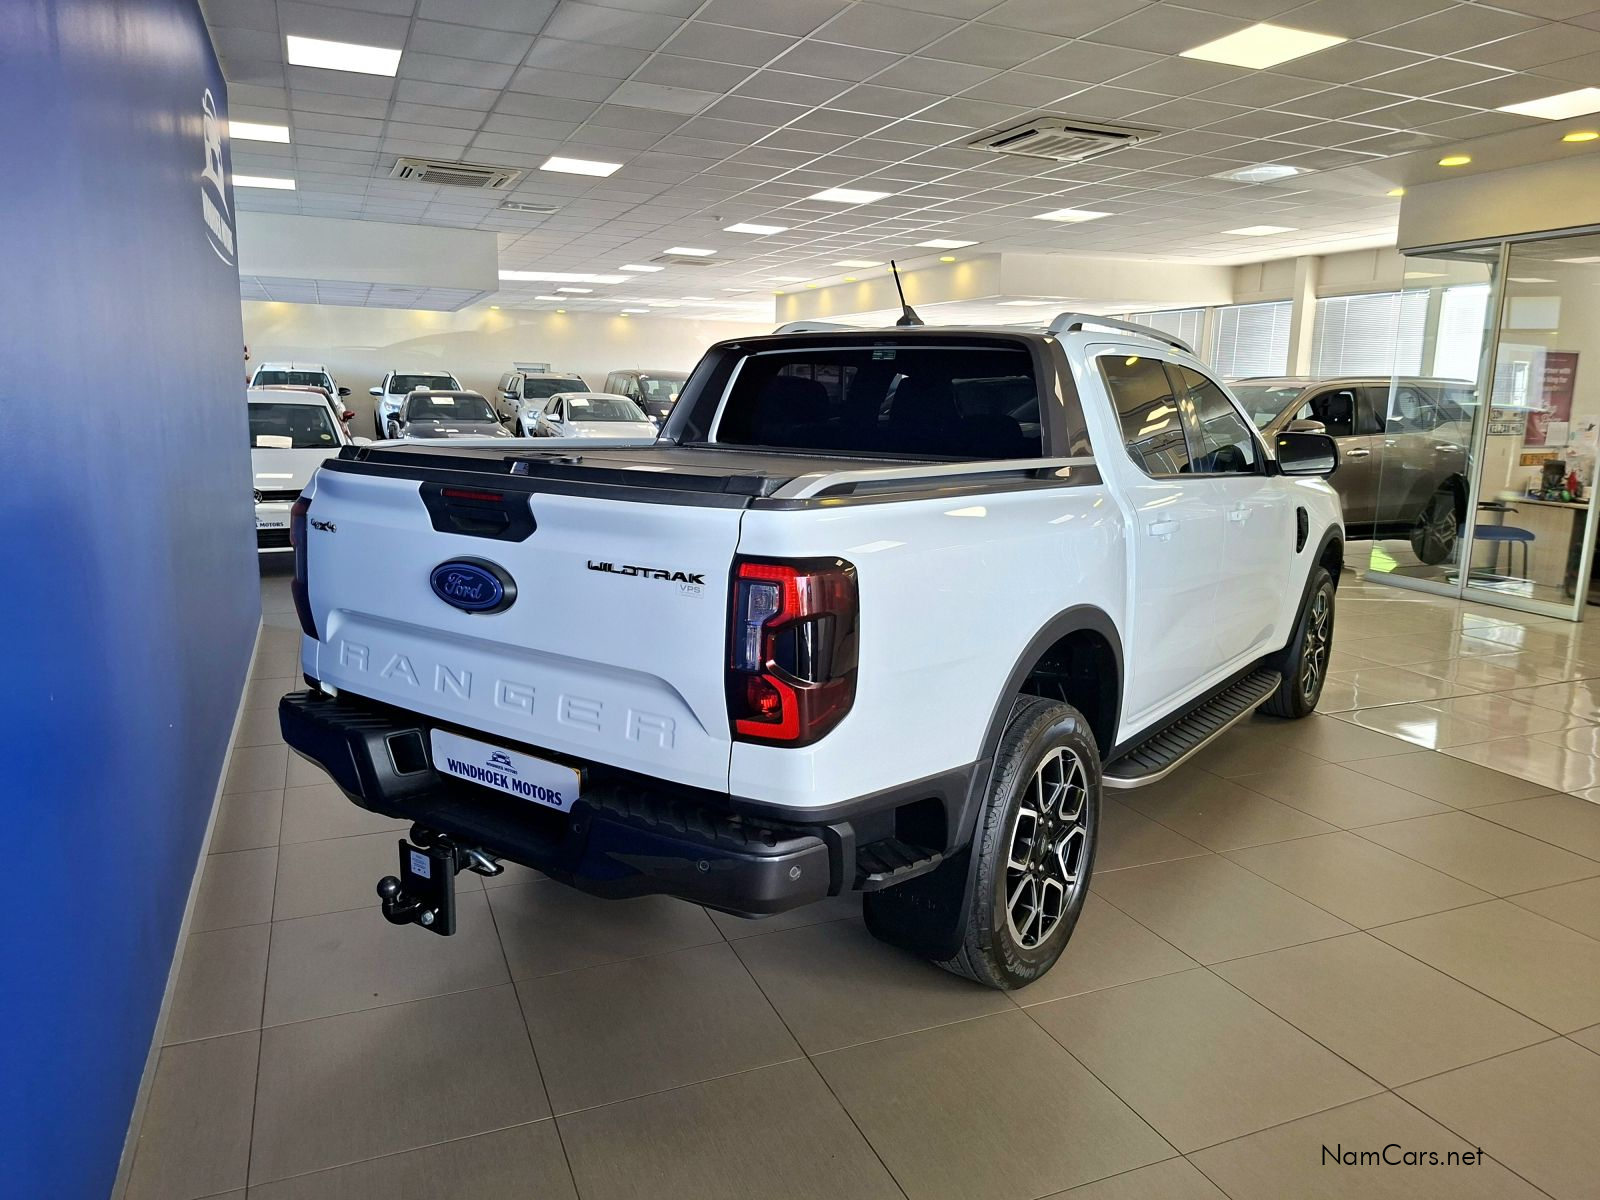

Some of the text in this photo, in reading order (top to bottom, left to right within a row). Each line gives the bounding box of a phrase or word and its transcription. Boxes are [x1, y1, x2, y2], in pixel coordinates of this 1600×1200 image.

[444, 572, 484, 600] Ford
[587, 560, 706, 585] WILDTRAK
[680, 584, 701, 593] VPS
[339, 639, 676, 749] RANGER
[447, 757, 562, 806] WINDHOEK MOTORS
